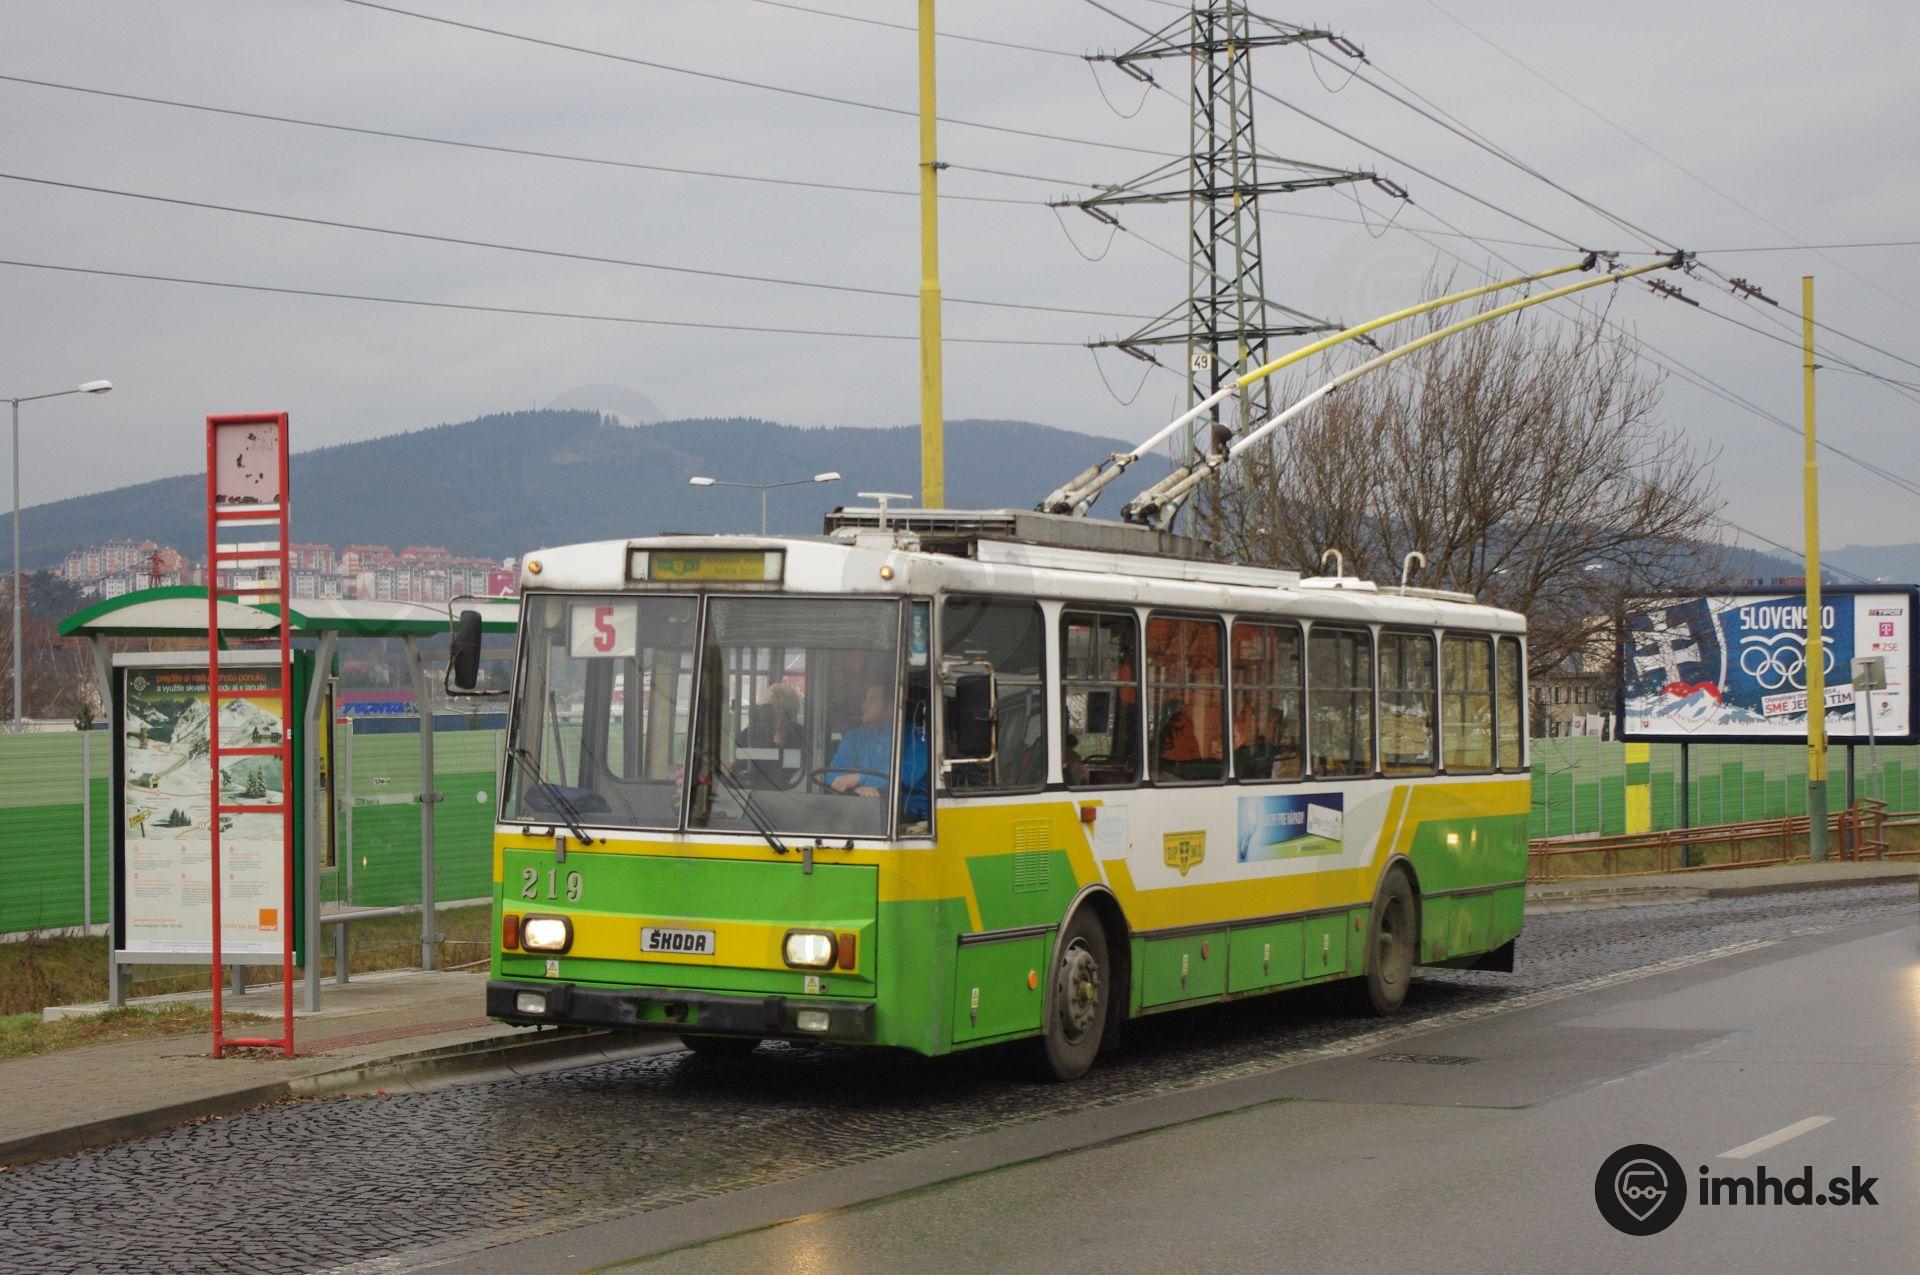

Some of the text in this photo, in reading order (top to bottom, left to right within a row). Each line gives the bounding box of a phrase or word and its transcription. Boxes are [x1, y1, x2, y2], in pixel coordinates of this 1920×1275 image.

[1194, 355, 1208, 369] 49
[1740, 606, 1835, 630] SLOVENSO
[594, 607, 616, 653] 5
[1765, 701, 1788, 714] SME
[522, 867, 584, 901] 219
[649, 929, 707, 951] ŠKODA
